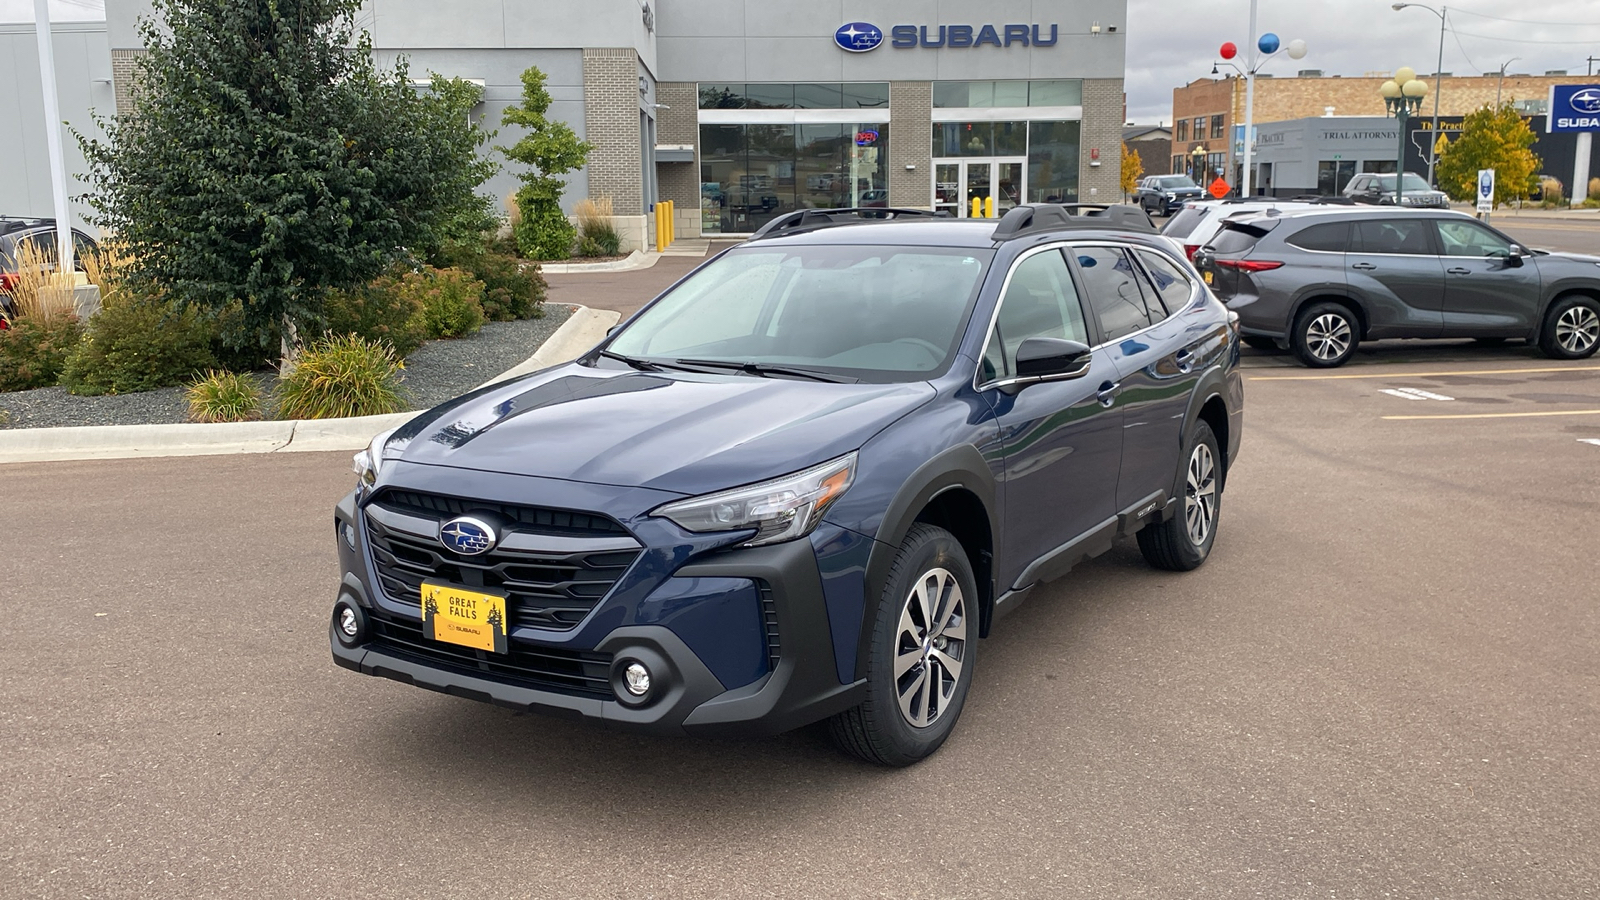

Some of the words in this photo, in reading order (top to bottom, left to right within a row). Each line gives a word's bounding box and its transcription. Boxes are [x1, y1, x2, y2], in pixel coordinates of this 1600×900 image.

[891, 24, 1058, 48] SUBARU
[1421, 121, 1432, 130] Th
[1440, 121, 1465, 130] Practi
[855, 131, 876, 142] OPEN
[1323, 131, 1350, 140] TRIAL
[449, 596, 476, 609] GREAT
[449, 606, 477, 620] FALLS
[455, 626, 480, 635] SUBARU
